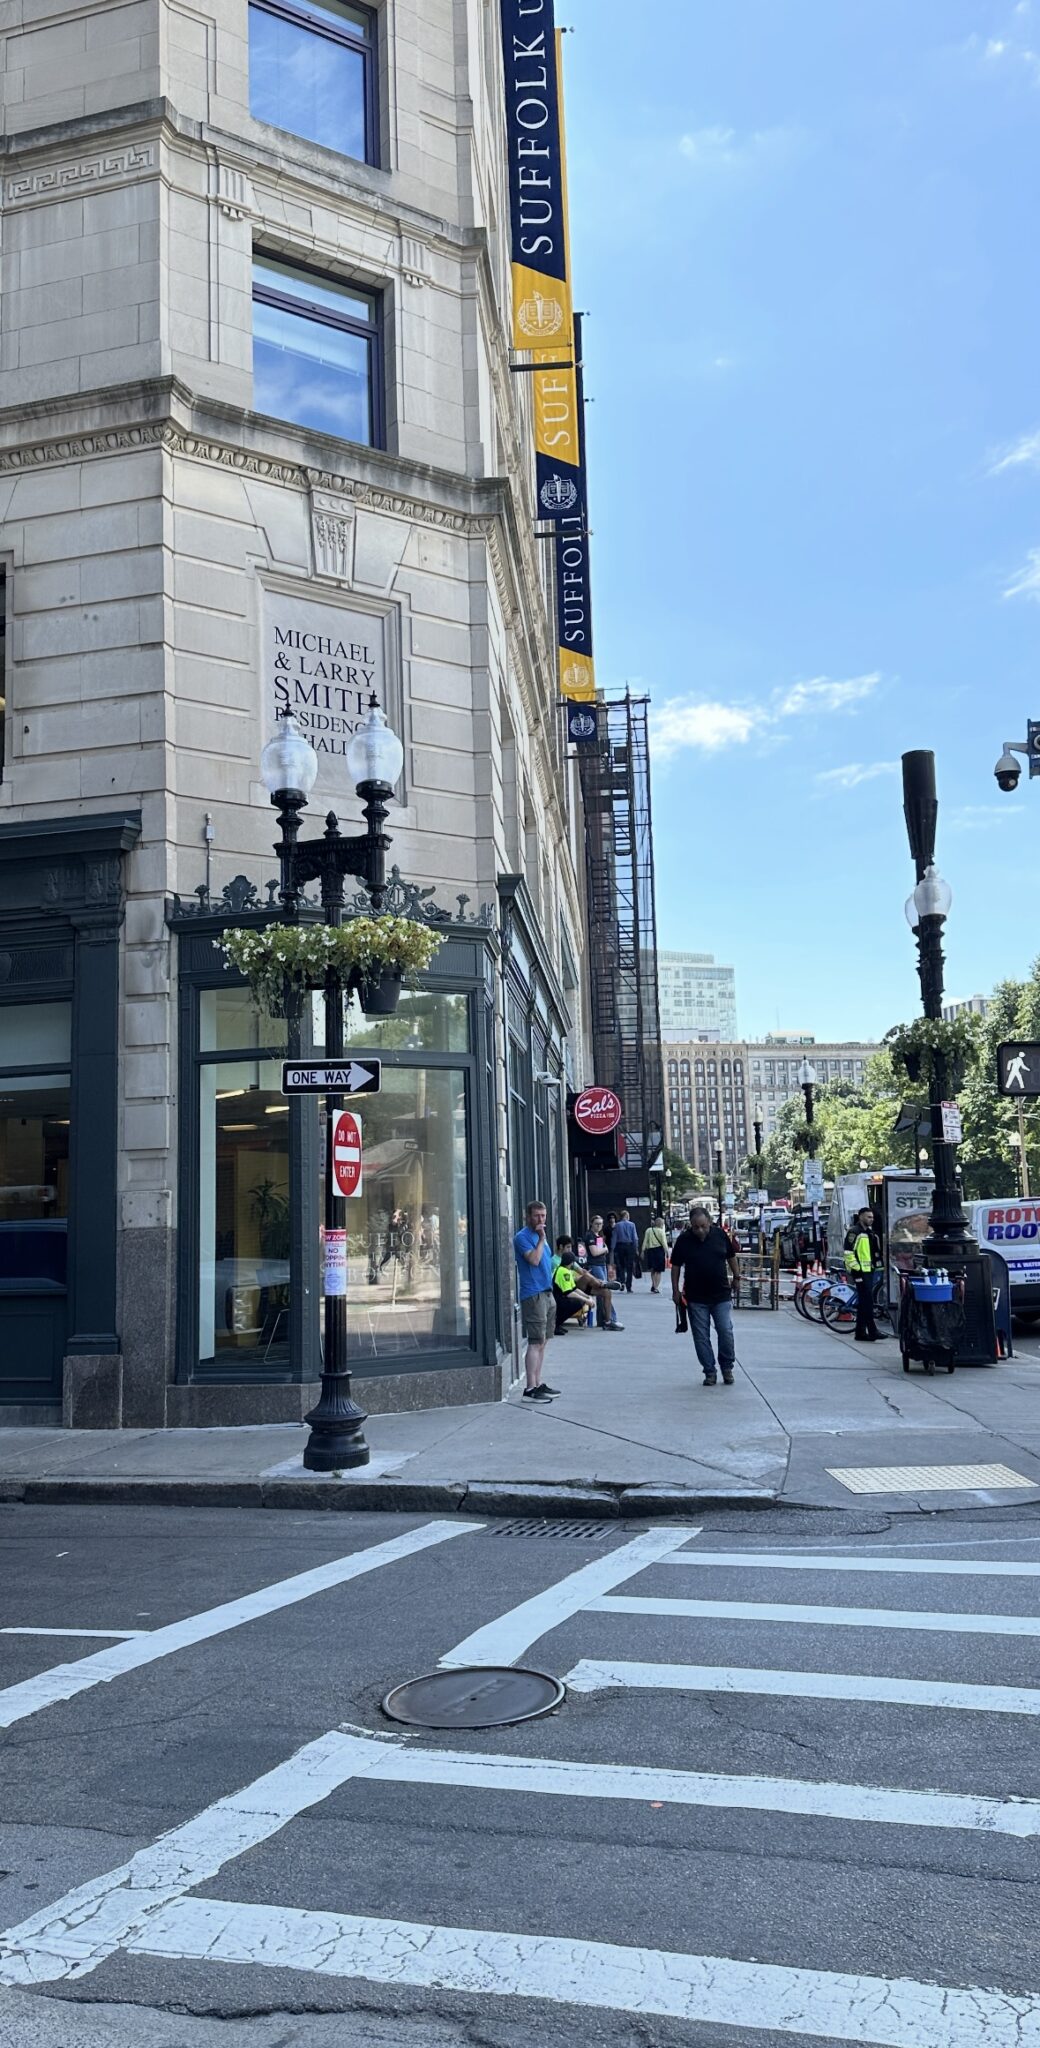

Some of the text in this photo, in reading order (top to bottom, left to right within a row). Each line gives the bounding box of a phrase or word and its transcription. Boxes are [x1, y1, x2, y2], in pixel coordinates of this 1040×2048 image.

[513, 30, 553, 254] SUFFOLK
[274, 626, 376, 665] MICHAEL
[274, 651, 376, 688] & LARRY
[274, 675, 373, 716] SMITH
[292, 1071, 352, 1084] ONE WAY
[578, 1094, 616, 1118] Sal's
[338, 1130, 357, 1144] DO NOT
[340, 1166, 356, 1178] ENTER
[987, 1222, 1040, 1241] ROO
